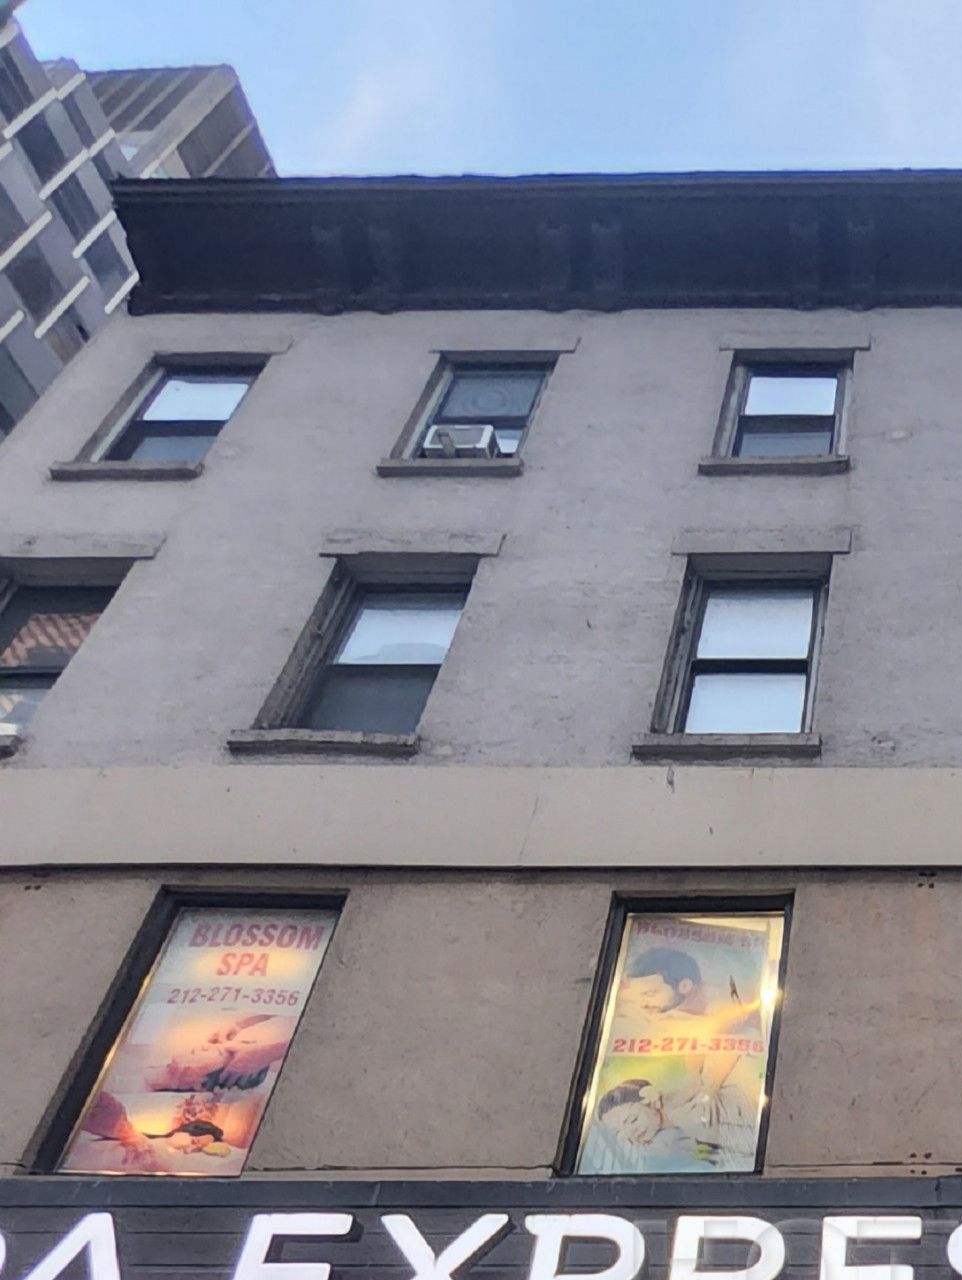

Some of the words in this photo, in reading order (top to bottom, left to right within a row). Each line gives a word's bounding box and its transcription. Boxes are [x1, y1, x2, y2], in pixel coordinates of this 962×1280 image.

[189, 921, 325, 950] BLOSSOM
[216, 952, 270, 977] SPA
[167, 986, 300, 1006] 212-271-3356
[613, 1036, 765, 1054] 212-271-3356
